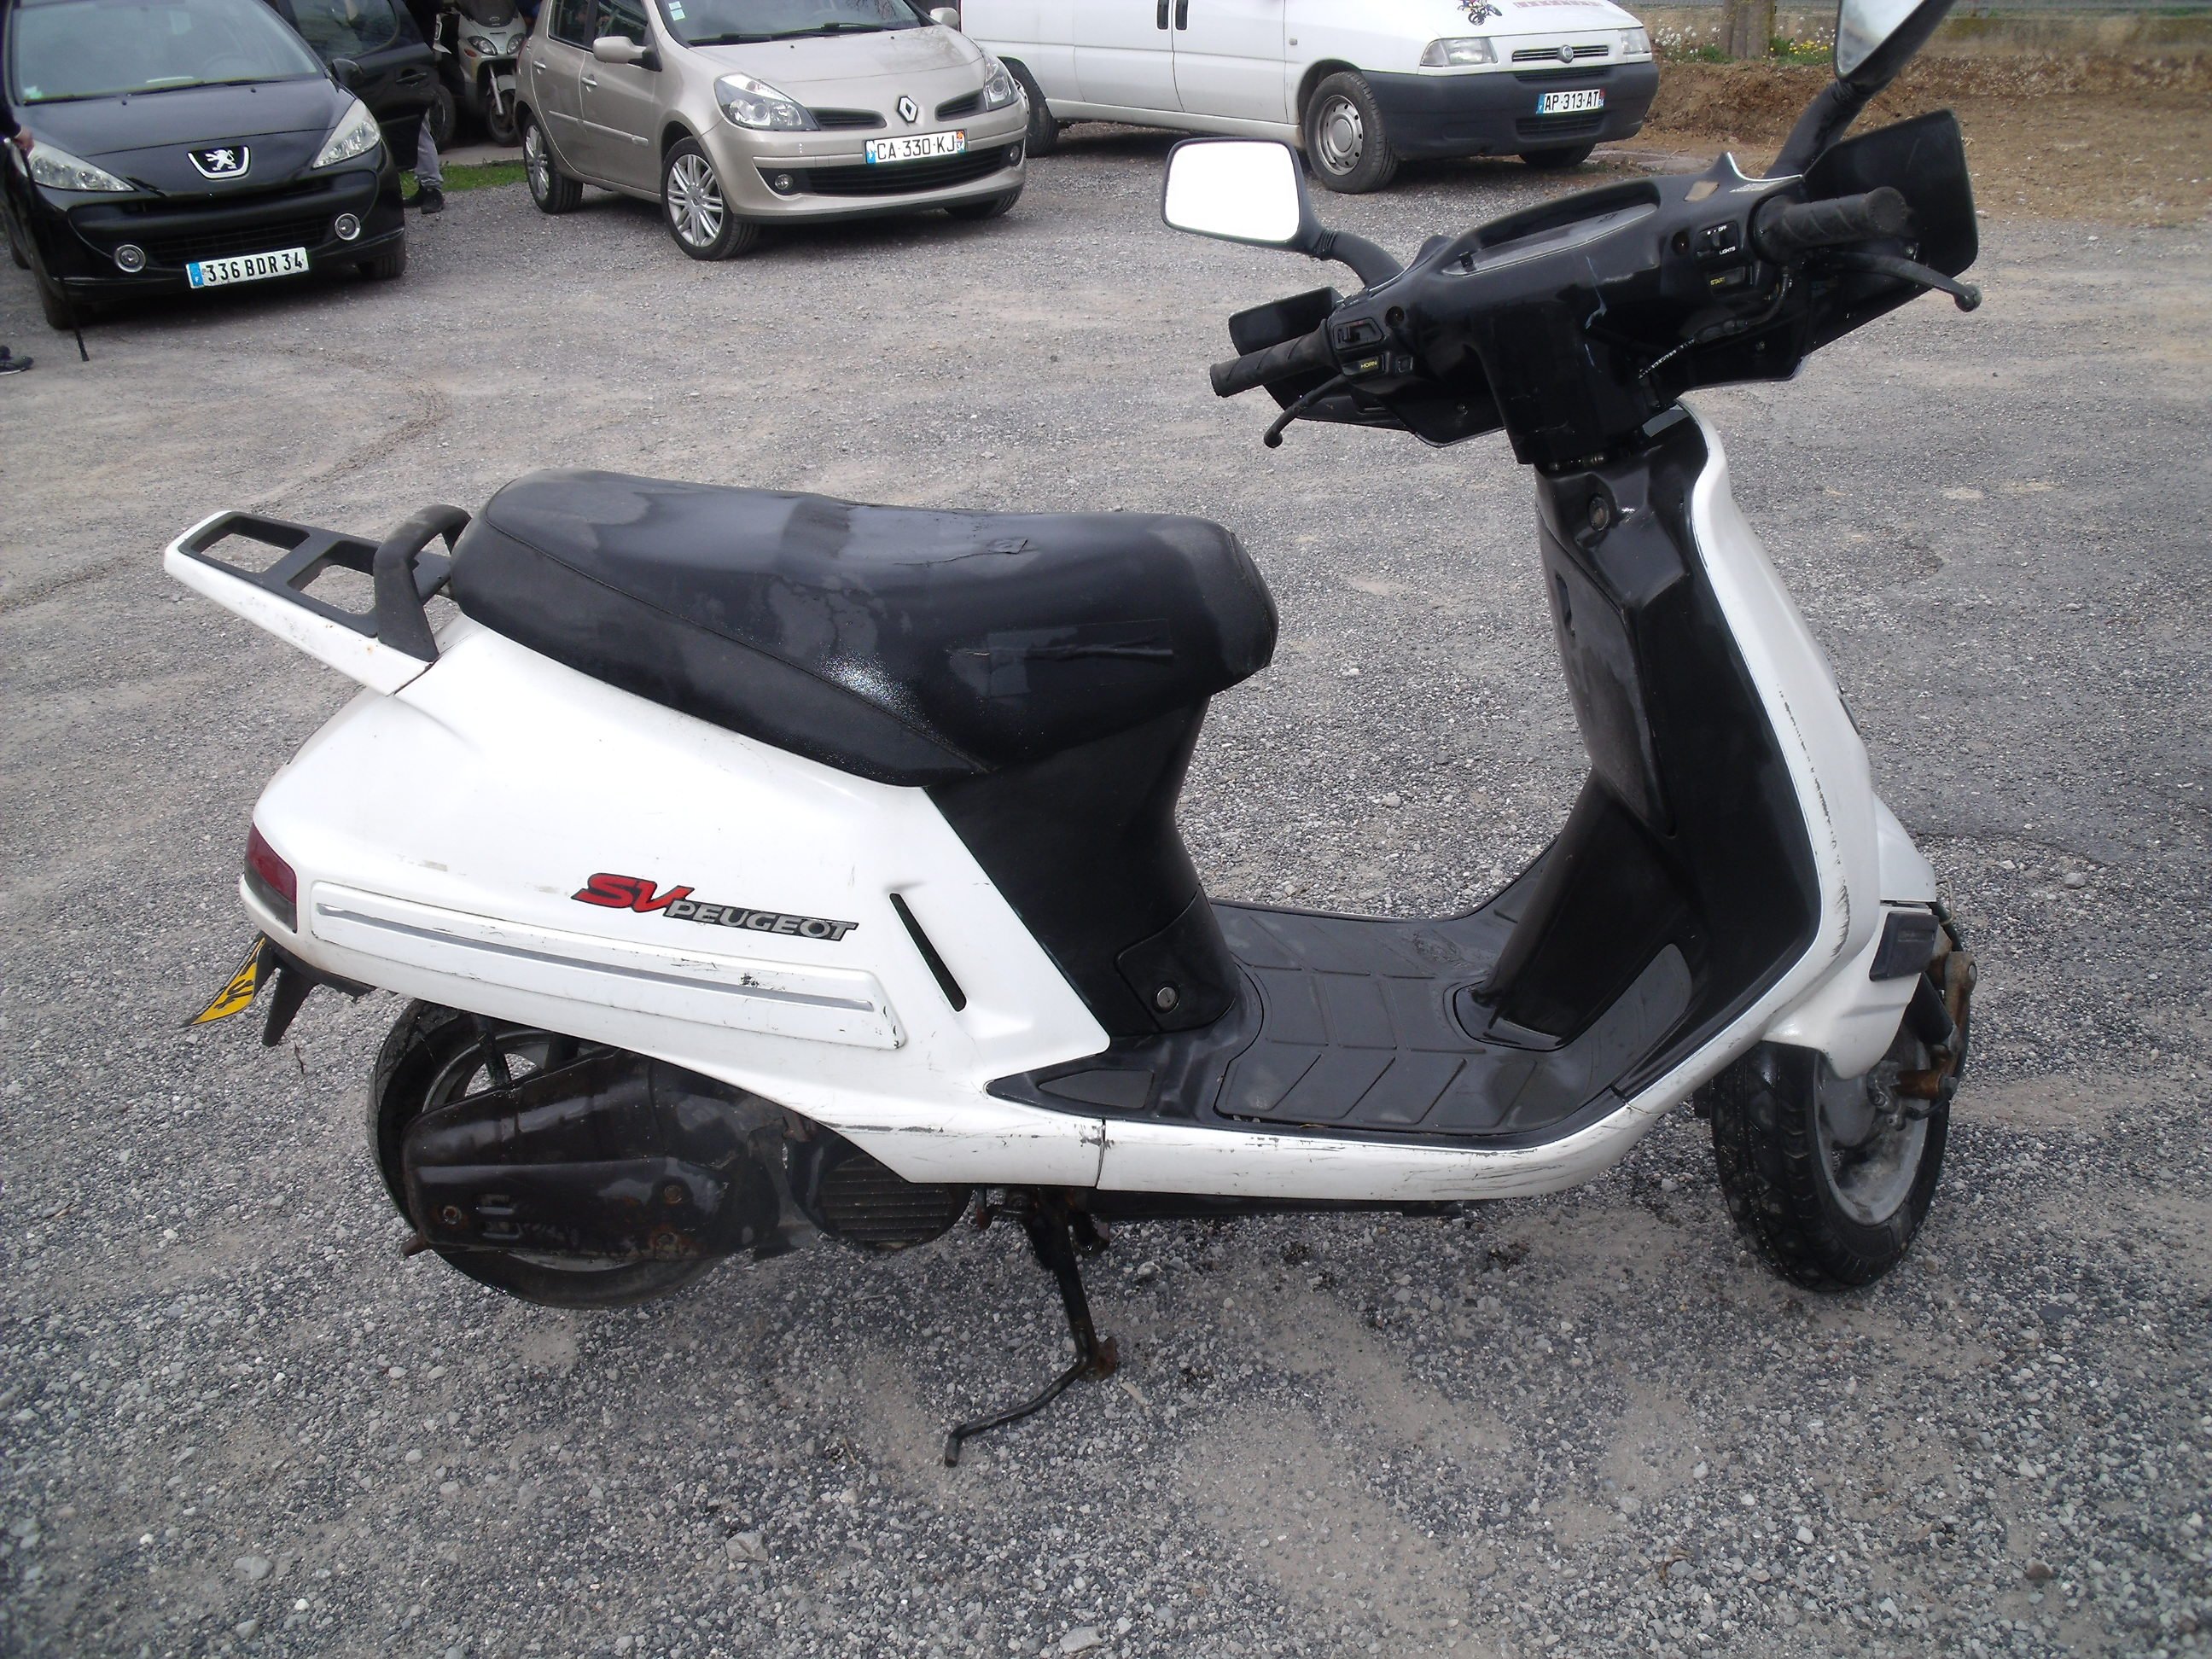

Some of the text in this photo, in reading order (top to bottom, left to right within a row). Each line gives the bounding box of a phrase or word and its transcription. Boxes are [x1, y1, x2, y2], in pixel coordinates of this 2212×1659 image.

[1719, 246, 1736, 255] LIGHTS
[207, 253, 303, 282] 336 BDR 34
[1360, 360, 1377, 369] HORN
[571, 873, 858, 940] SV PEUGEOT
